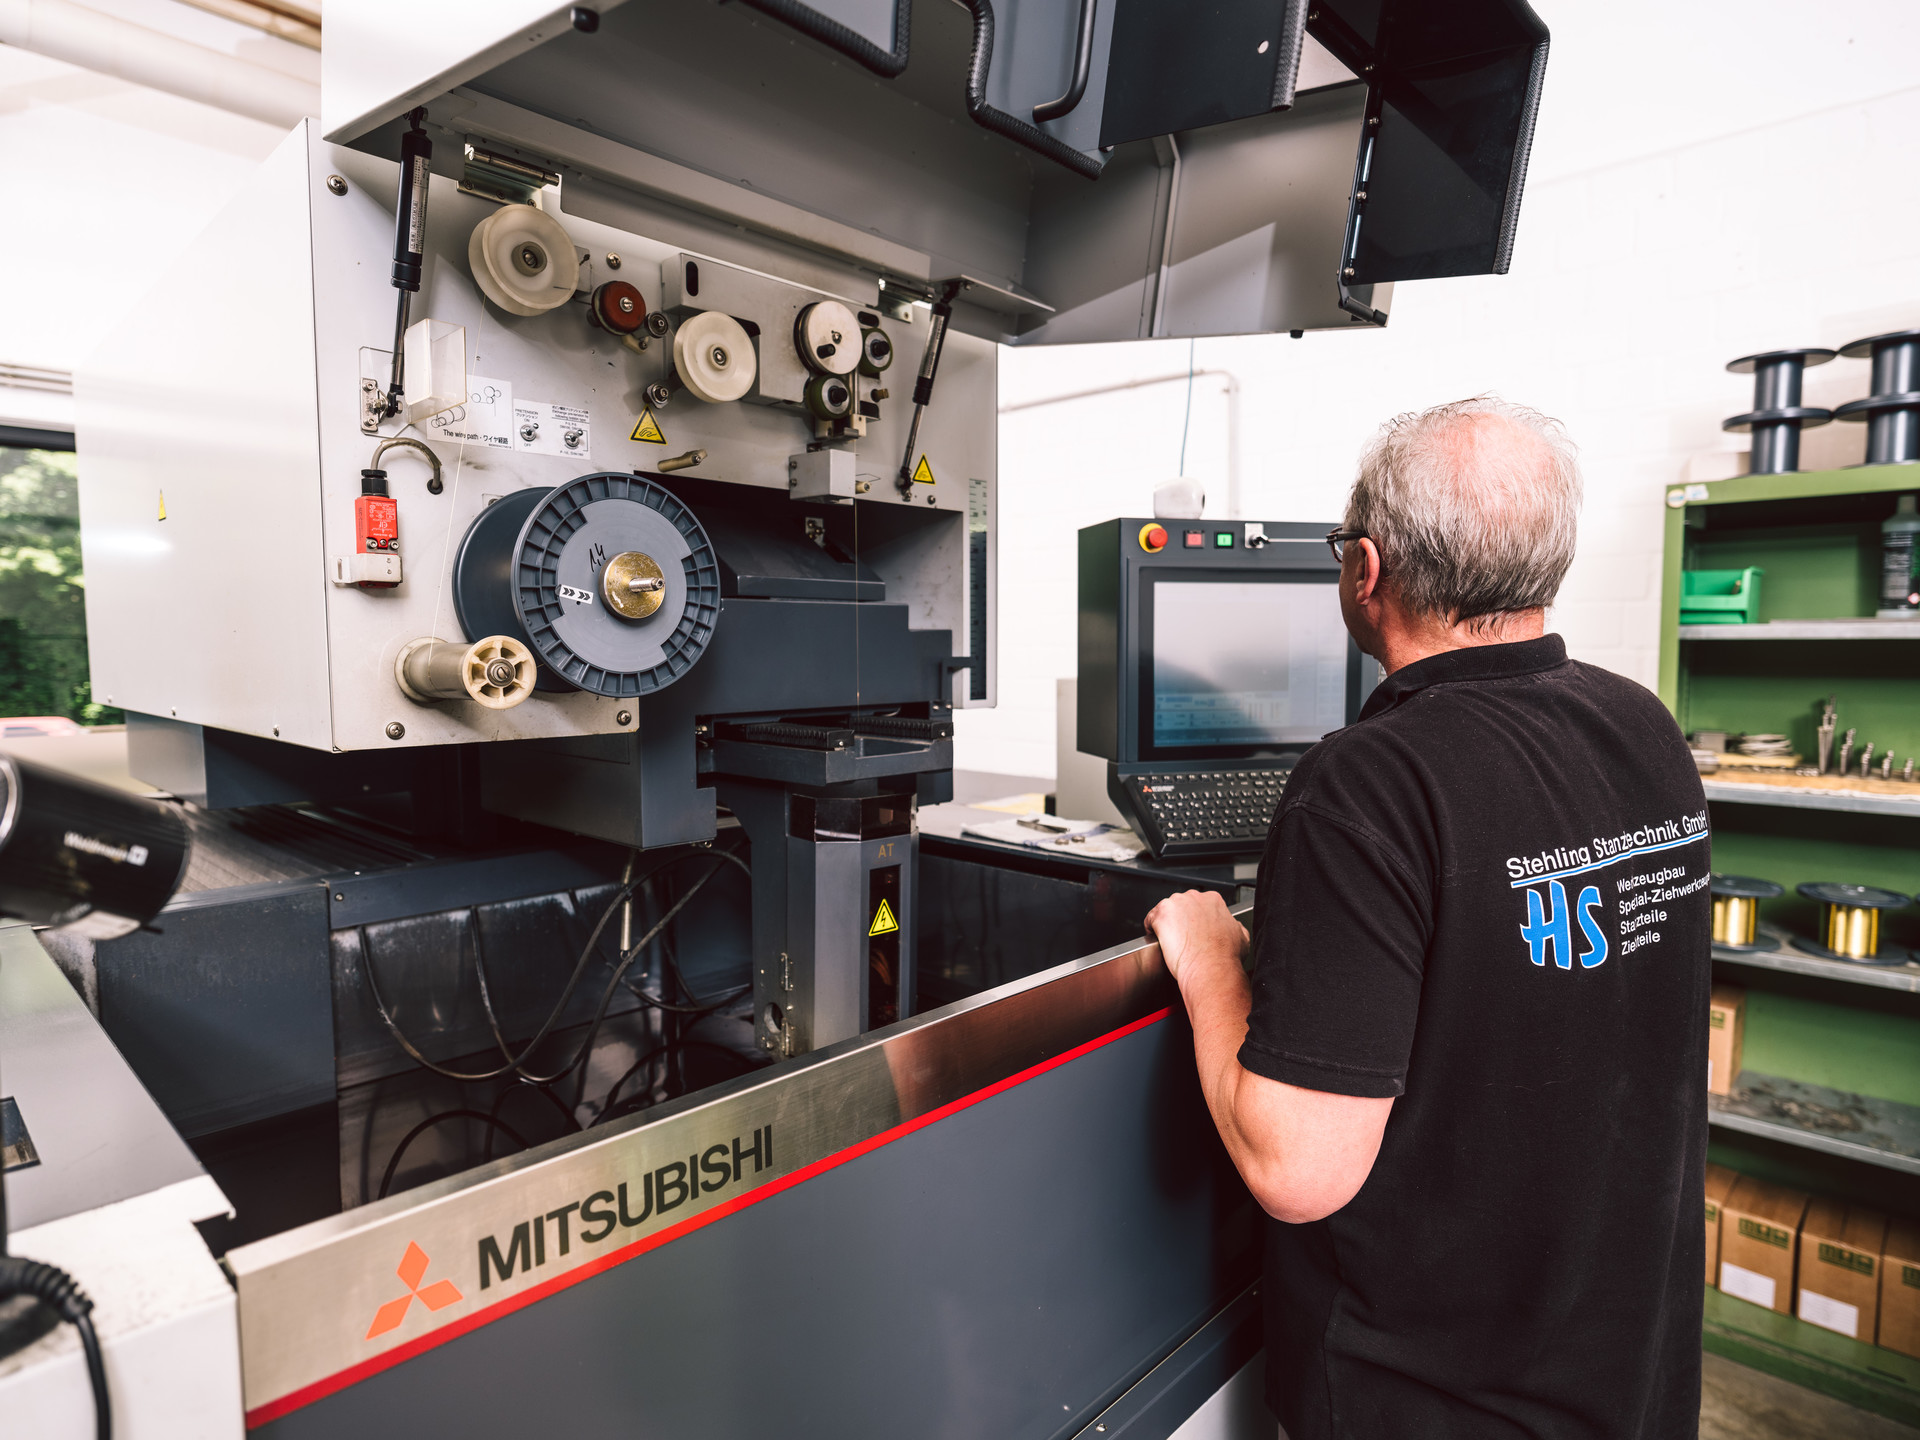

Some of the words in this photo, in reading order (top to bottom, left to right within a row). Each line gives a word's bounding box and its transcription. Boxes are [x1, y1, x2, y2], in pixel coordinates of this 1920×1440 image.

[443, 429, 454, 437] The
[878, 843, 895, 858] AT
[1506, 846, 1591, 878] Stehling
[1593, 820, 1681, 858] Stanzechnik
[1616, 866, 1686, 894] Wezeugbau
[1619, 872, 1711, 915] Speial-Ziehwerkzeuge
[1519, 879, 1609, 970] HS
[1620, 909, 1667, 935] Stazteile
[478, 1124, 774, 1291] MITSUBISHI
